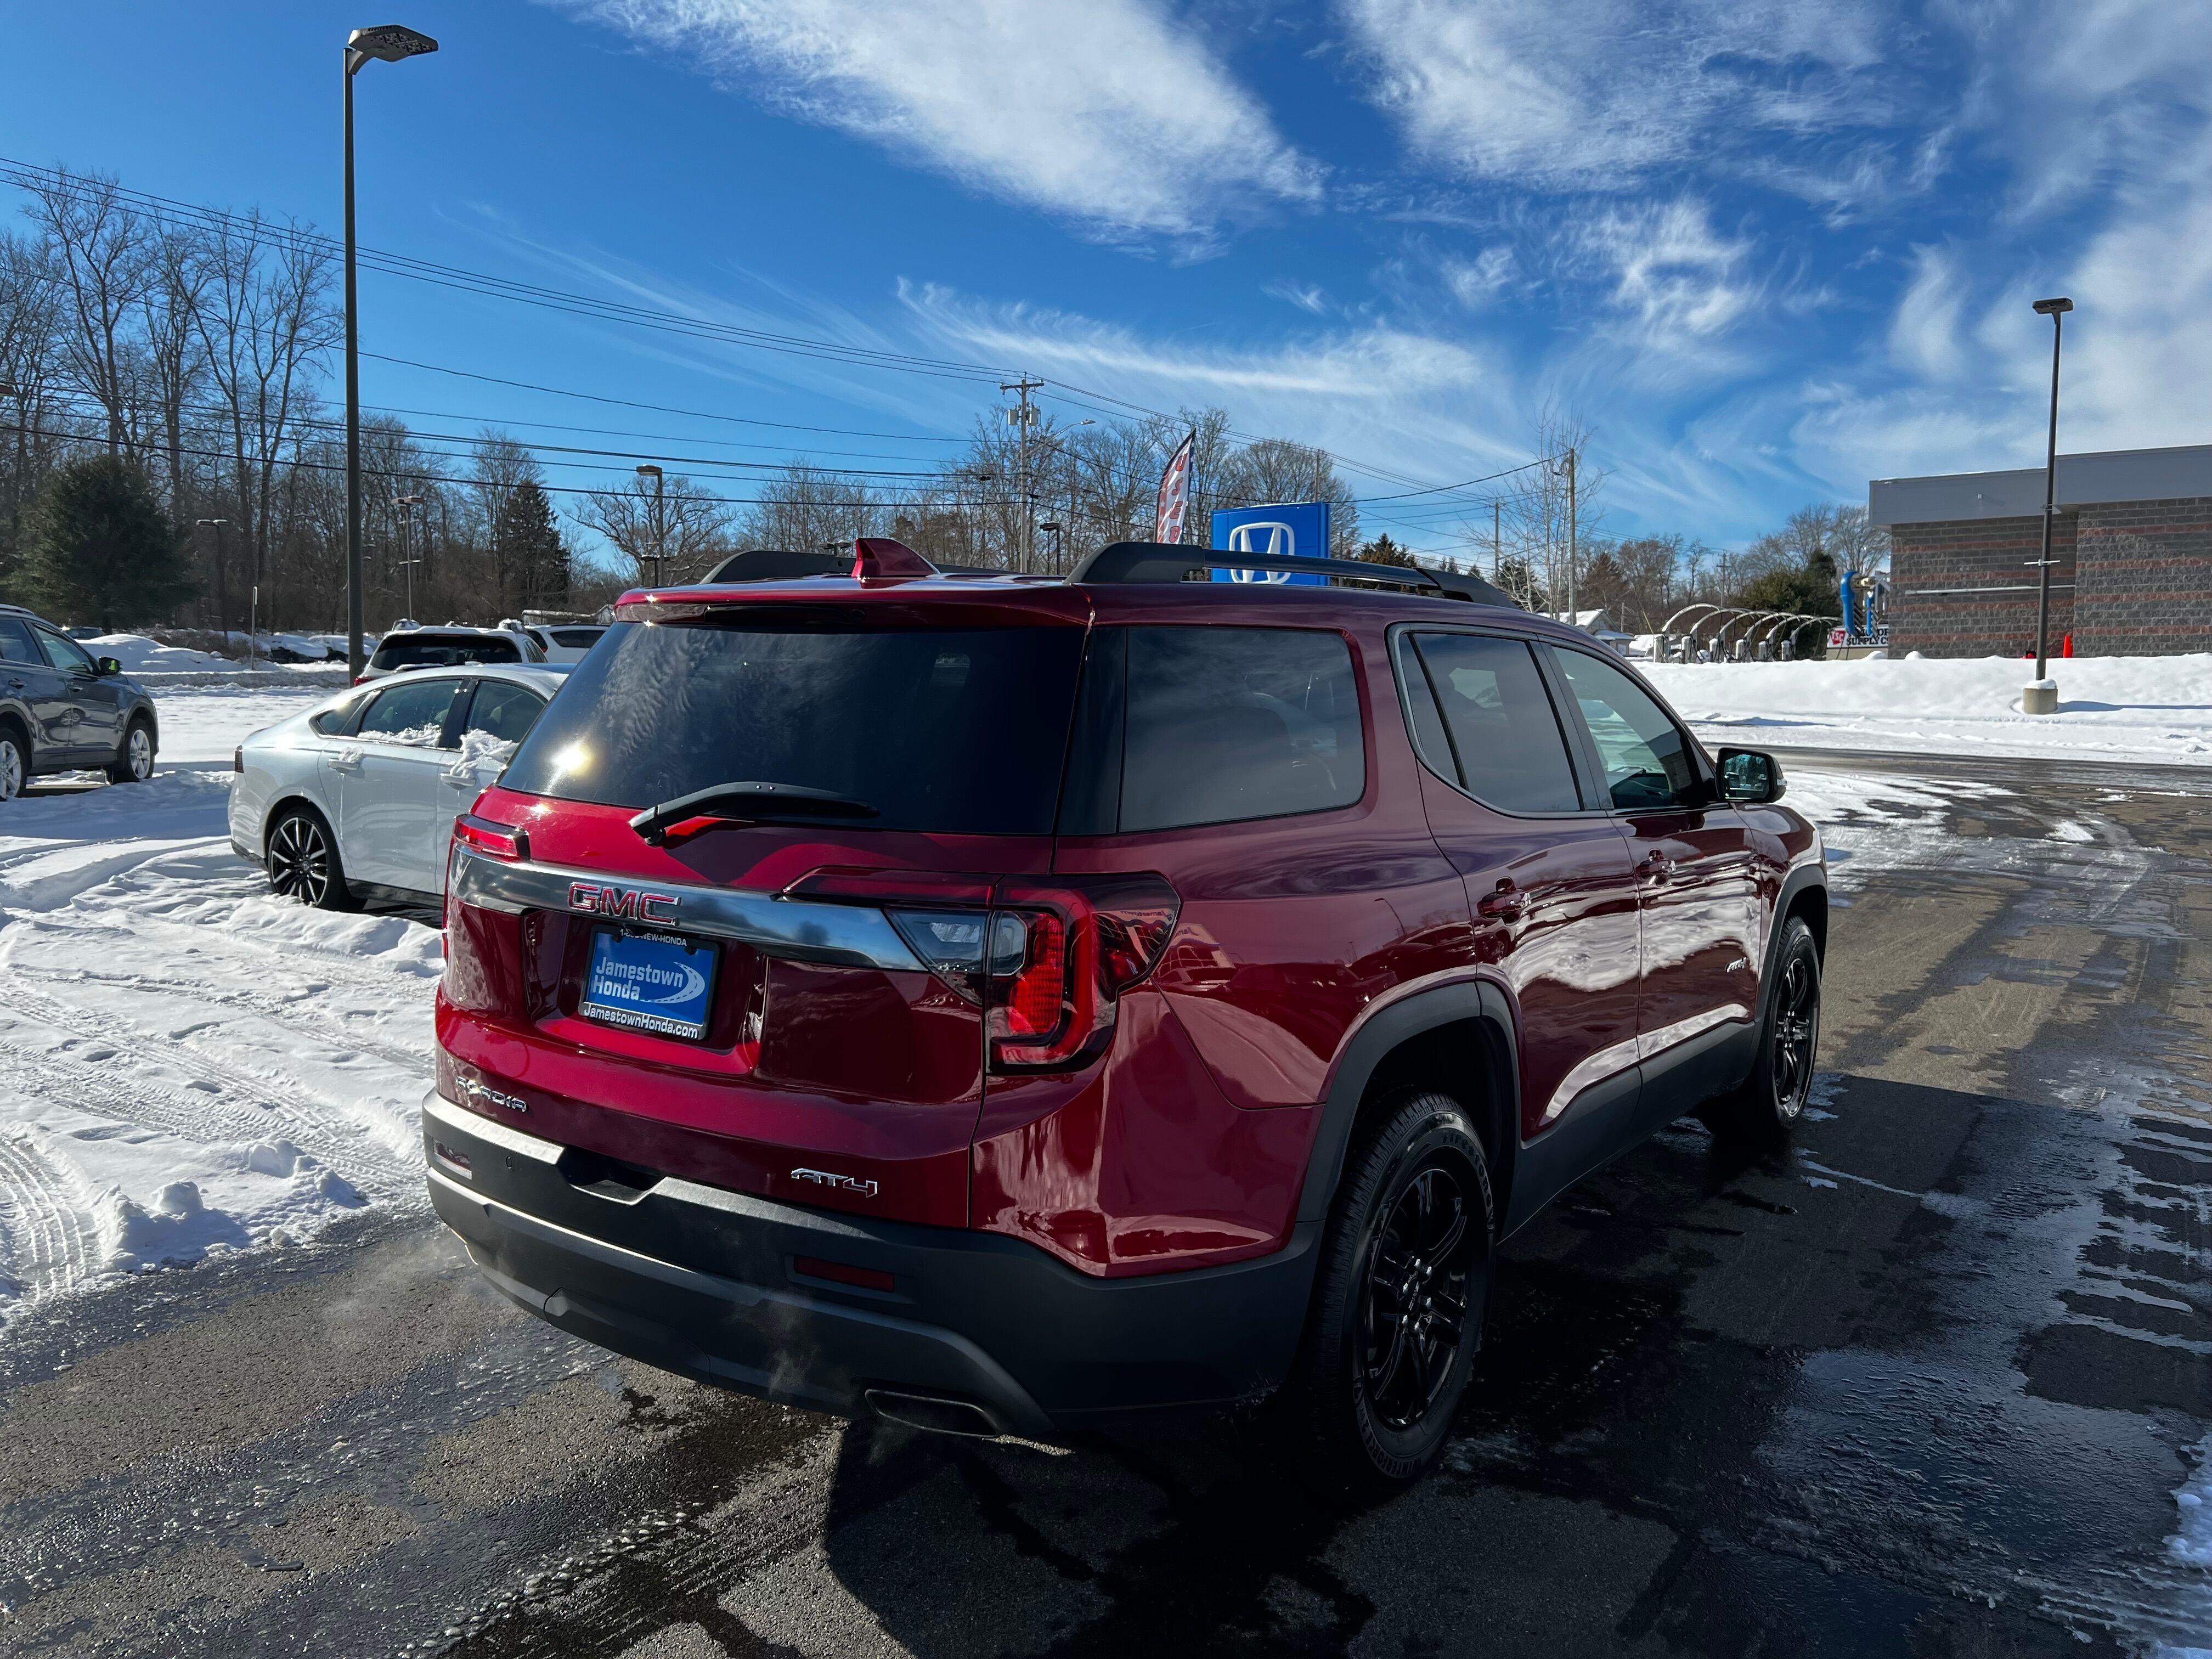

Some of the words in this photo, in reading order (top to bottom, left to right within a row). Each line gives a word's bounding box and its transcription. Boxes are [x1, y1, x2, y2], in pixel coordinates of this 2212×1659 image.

[1169, 453, 1189, 543] USED
[1831, 631, 1844, 642] TSC
[1881, 637, 1888, 645] C
[568, 882, 682, 927] GMC
[592, 974, 641, 1001] Honda
[596, 957, 684, 988] Jamestown
[584, 1005, 698, 1039] JamestownHonda.com
[791, 1167, 878, 1198] AT4
[1442, 1131, 1492, 1207] Firestone
